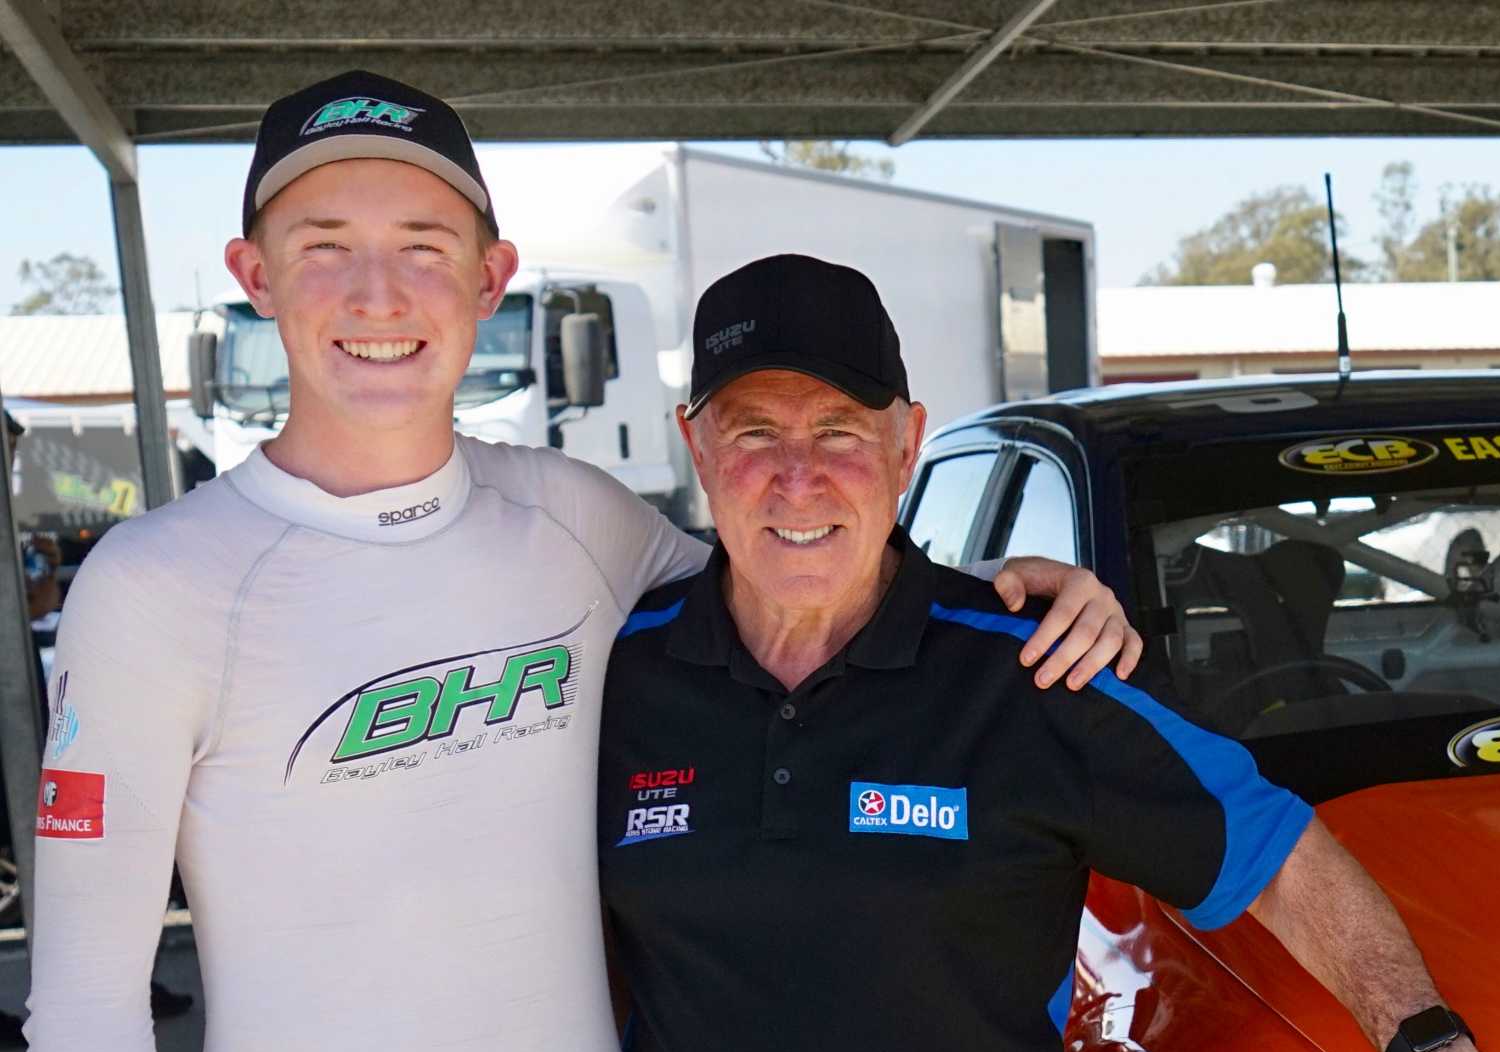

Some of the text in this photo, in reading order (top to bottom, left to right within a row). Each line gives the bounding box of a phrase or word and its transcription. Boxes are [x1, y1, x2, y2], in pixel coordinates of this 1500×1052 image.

[313, 100, 411, 126] BHR
[706, 319, 757, 351] ISUZU
[713, 335, 743, 355] UTE
[1301, 439, 1417, 465] ECB
[378, 497, 440, 526] sparco
[331, 646, 572, 764] BHR
[320, 714, 573, 784] Bayley Hall Racing
[637, 787, 678, 801] UTE
[46, 814, 92, 832] FINANCE
[627, 804, 690, 833] RSR
[853, 794, 956, 830] CALTEX Delo
